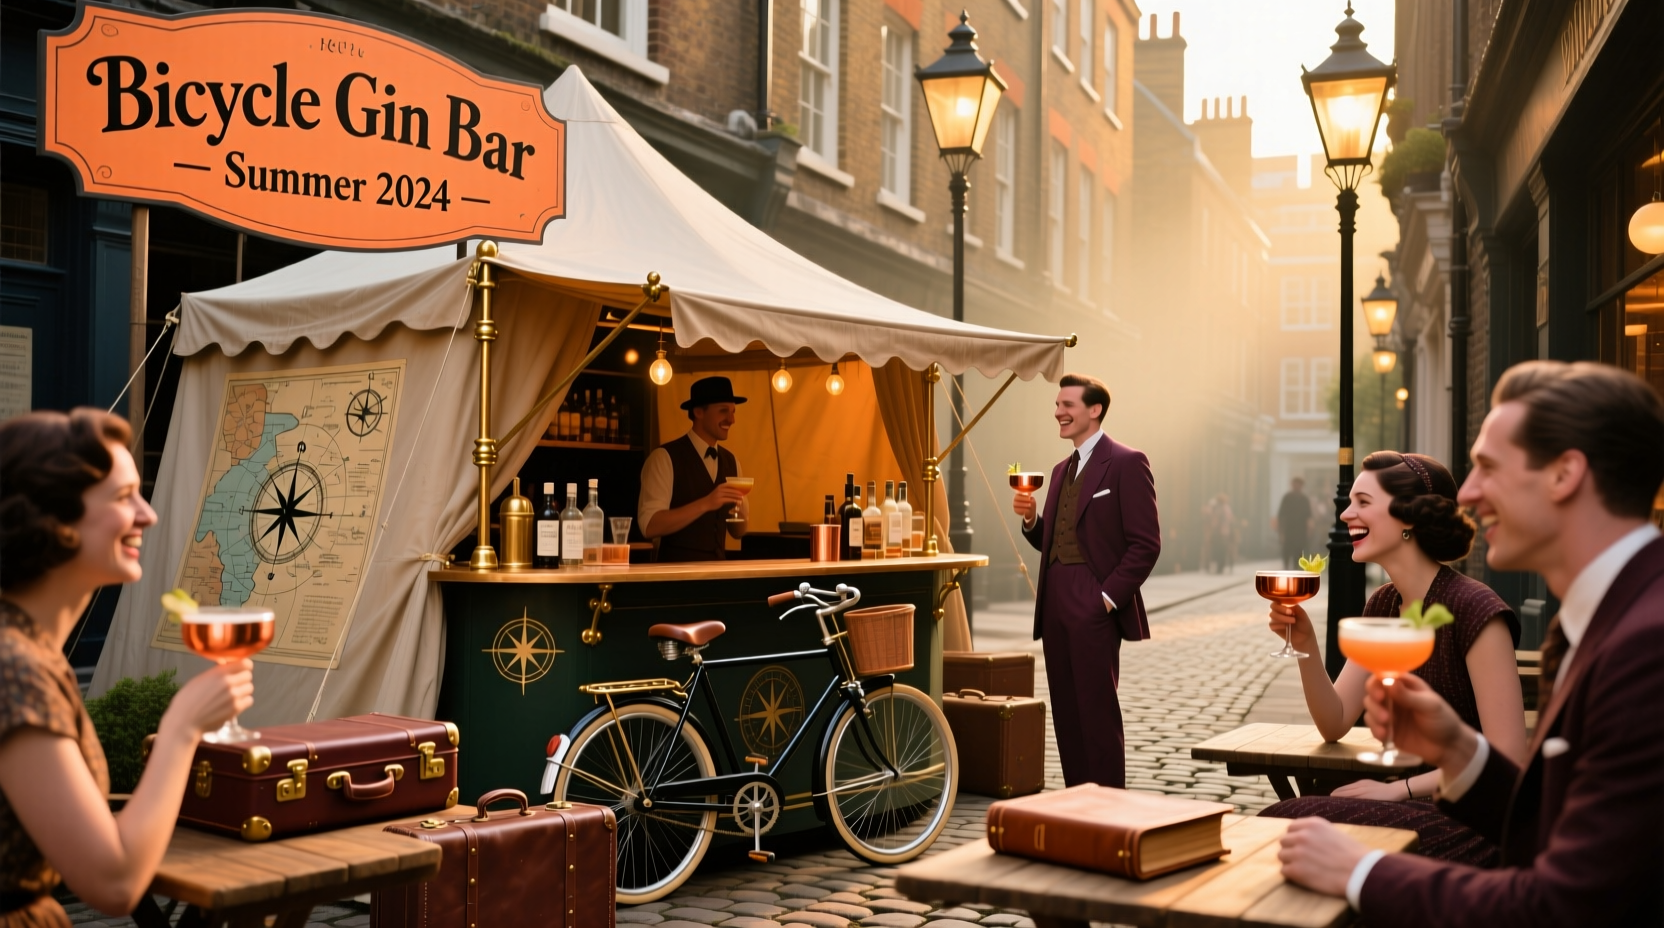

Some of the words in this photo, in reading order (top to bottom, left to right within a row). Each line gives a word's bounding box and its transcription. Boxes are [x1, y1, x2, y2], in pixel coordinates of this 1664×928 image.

[86, 55, 321, 147] Bicycle
[335, 72, 431, 151] Gin
[442, 94, 536, 181] Bar
[224, 150, 367, 202] Summer
[376, 172, 451, 212] 2024
